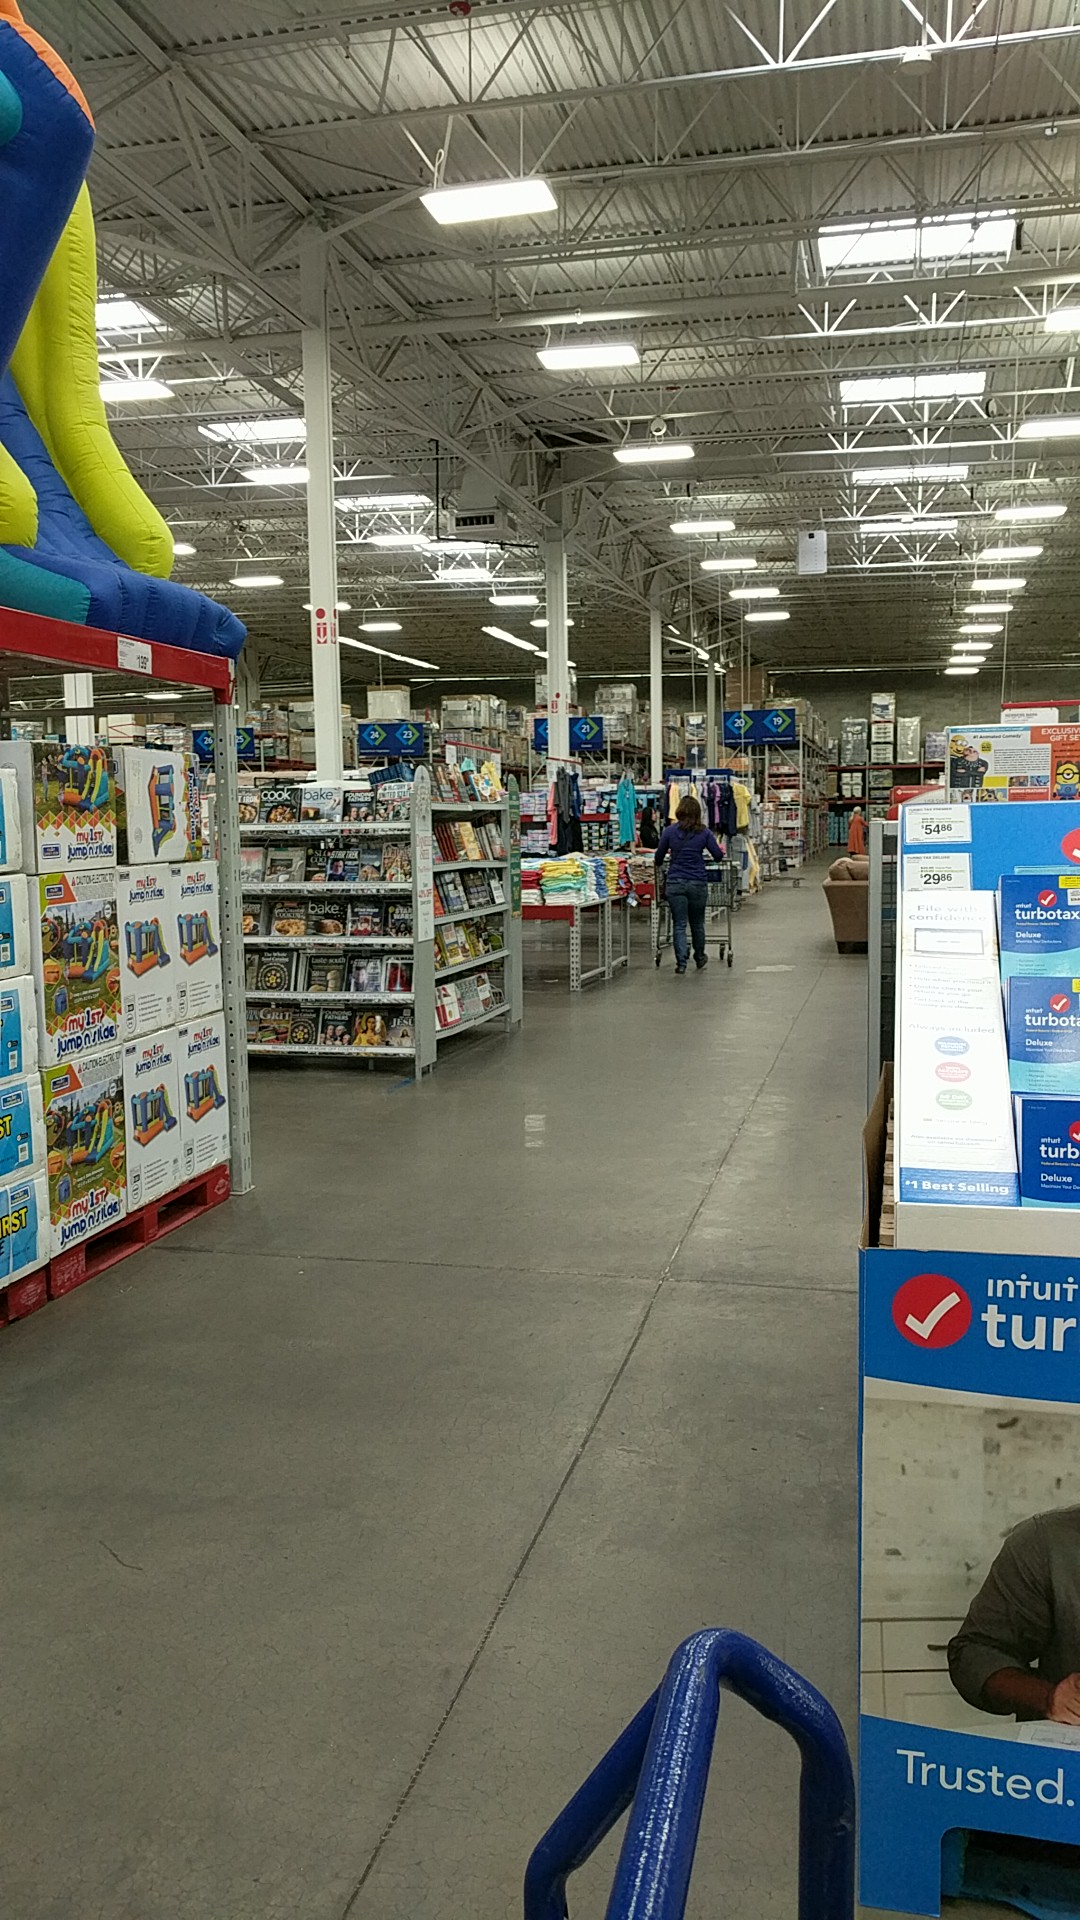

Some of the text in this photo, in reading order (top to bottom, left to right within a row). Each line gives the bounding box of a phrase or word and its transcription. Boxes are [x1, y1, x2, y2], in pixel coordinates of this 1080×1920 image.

[734, 717, 783, 727] 20 19
[370, 730, 413, 739] 24 23
[581, 725, 590, 733] 21
[203, 736, 213, 744] 26
[261, 787, 291, 800] cook
[303, 788, 333, 800] bake
[76, 831, 88, 843] my
[186, 874, 196, 883] my
[136, 880, 146, 891] my
[308, 900, 340, 914] bake
[947, 904, 977, 912] with
[1015, 907, 1080, 920] turbotax
[68, 1014, 84, 1032] my
[948, 1026, 995, 1034] included
[57, 1036, 82, 1058] jump
[93, 1025, 115, 1042] slide
[193, 1032, 203, 1041] my
[142, 1049, 152, 1058] my
[1039, 1143, 1079, 1159] turb
[1041, 1173, 1072, 1182] Deluxe
[922, 1181, 954, 1191] Best
[957, 1183, 1009, 1195] Selling
[72, 1198, 88, 1217] my
[60, 1219, 87, 1246] jump
[96, 1201, 118, 1223] slide
[987, 1273, 1079, 1302] intuit
[980, 1304, 1077, 1351] tur
[896, 1748, 1075, 1807] Trusted.
